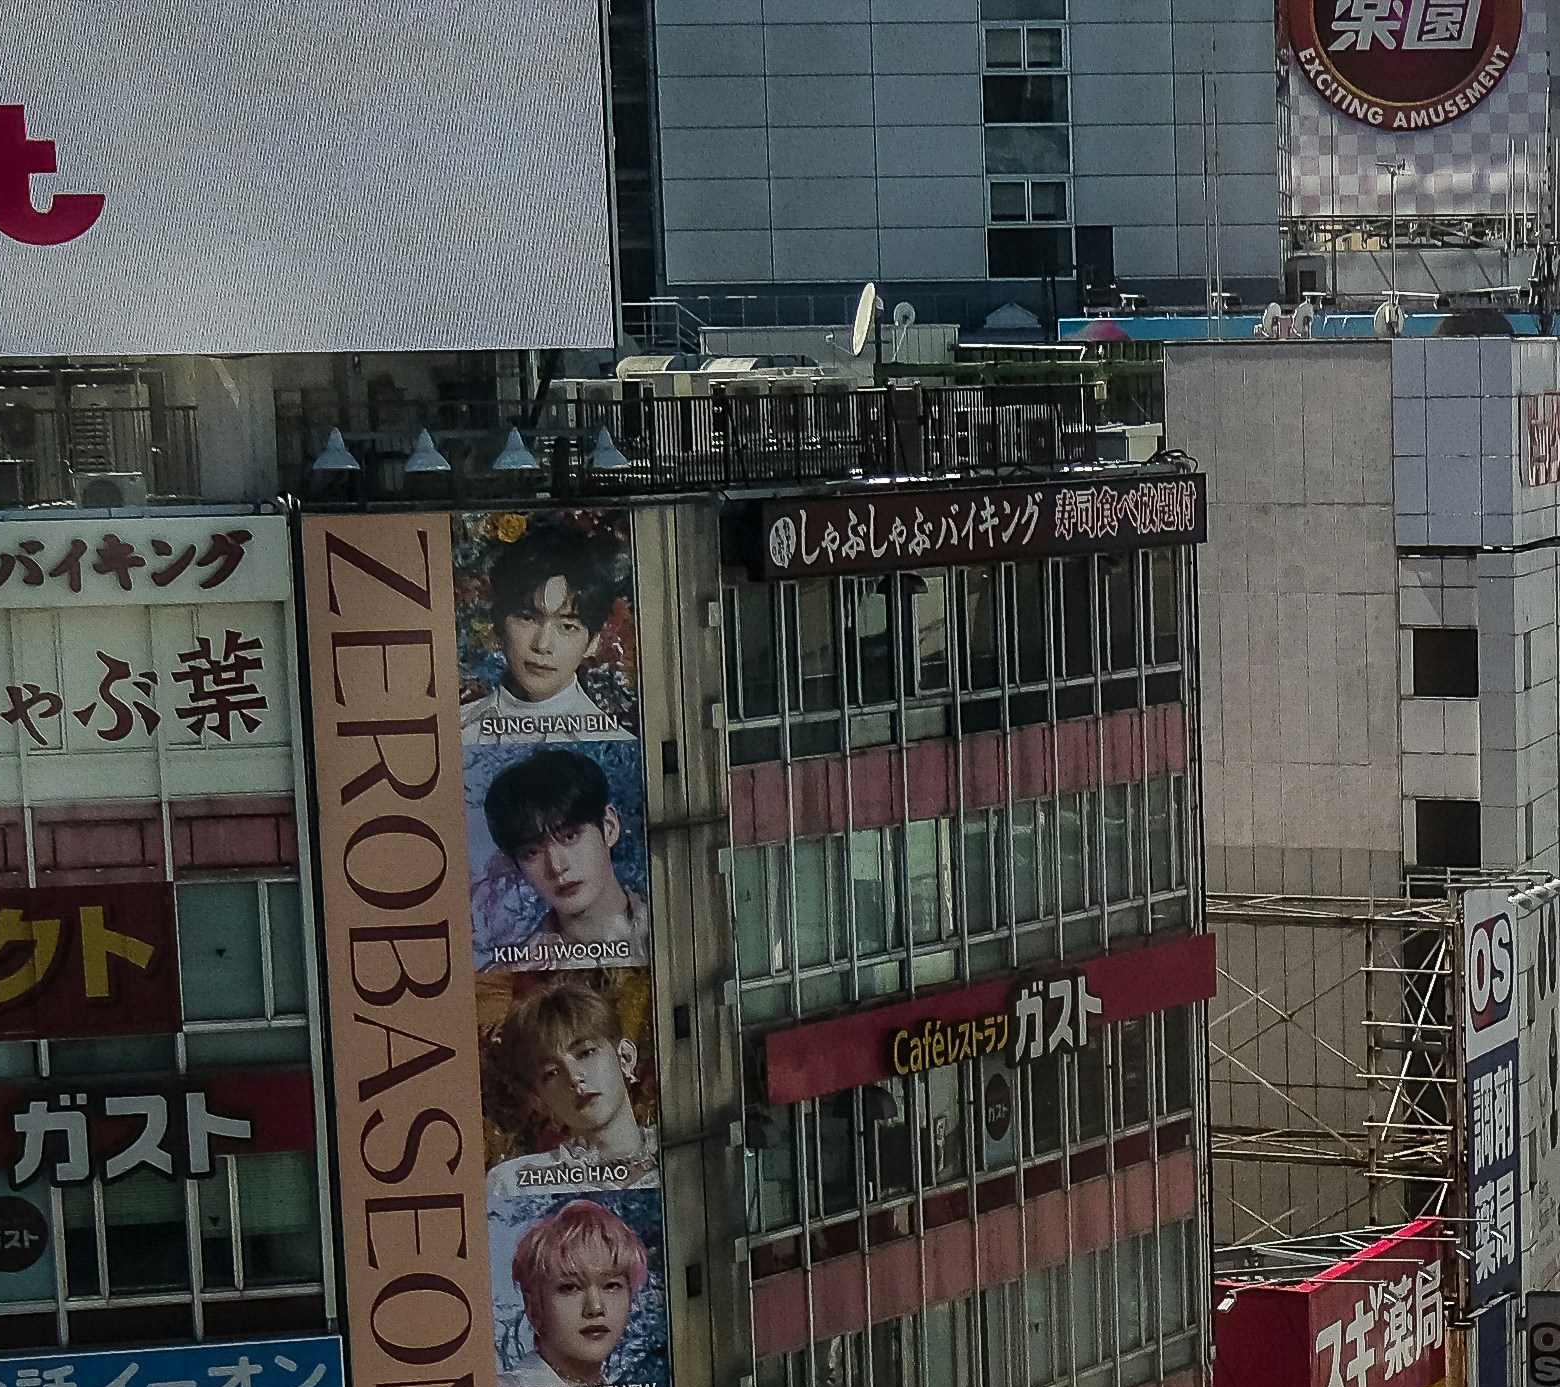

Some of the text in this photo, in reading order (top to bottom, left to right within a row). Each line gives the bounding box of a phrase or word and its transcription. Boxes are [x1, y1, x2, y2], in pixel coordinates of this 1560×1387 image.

[1299, 43, 1511, 130] EXCITING AMUSEMENT
[798, 484, 1196, 567] しゃぶしゃぶバイキング 寿司食べ放題付
[482, 713, 619, 736] SUNG HAN BIN
[493, 940, 631, 963] KIM JI WOONG
[1470, 915, 1514, 1014] OS
[1012, 970, 1104, 1058] ガスト
[10, 1090, 253, 1190] ガスト
[1472, 1064, 1516, 1176] 調剤
[518, 1164, 630, 1187] ZHANG HAO
[1474, 1168, 1517, 1286] 薬局
